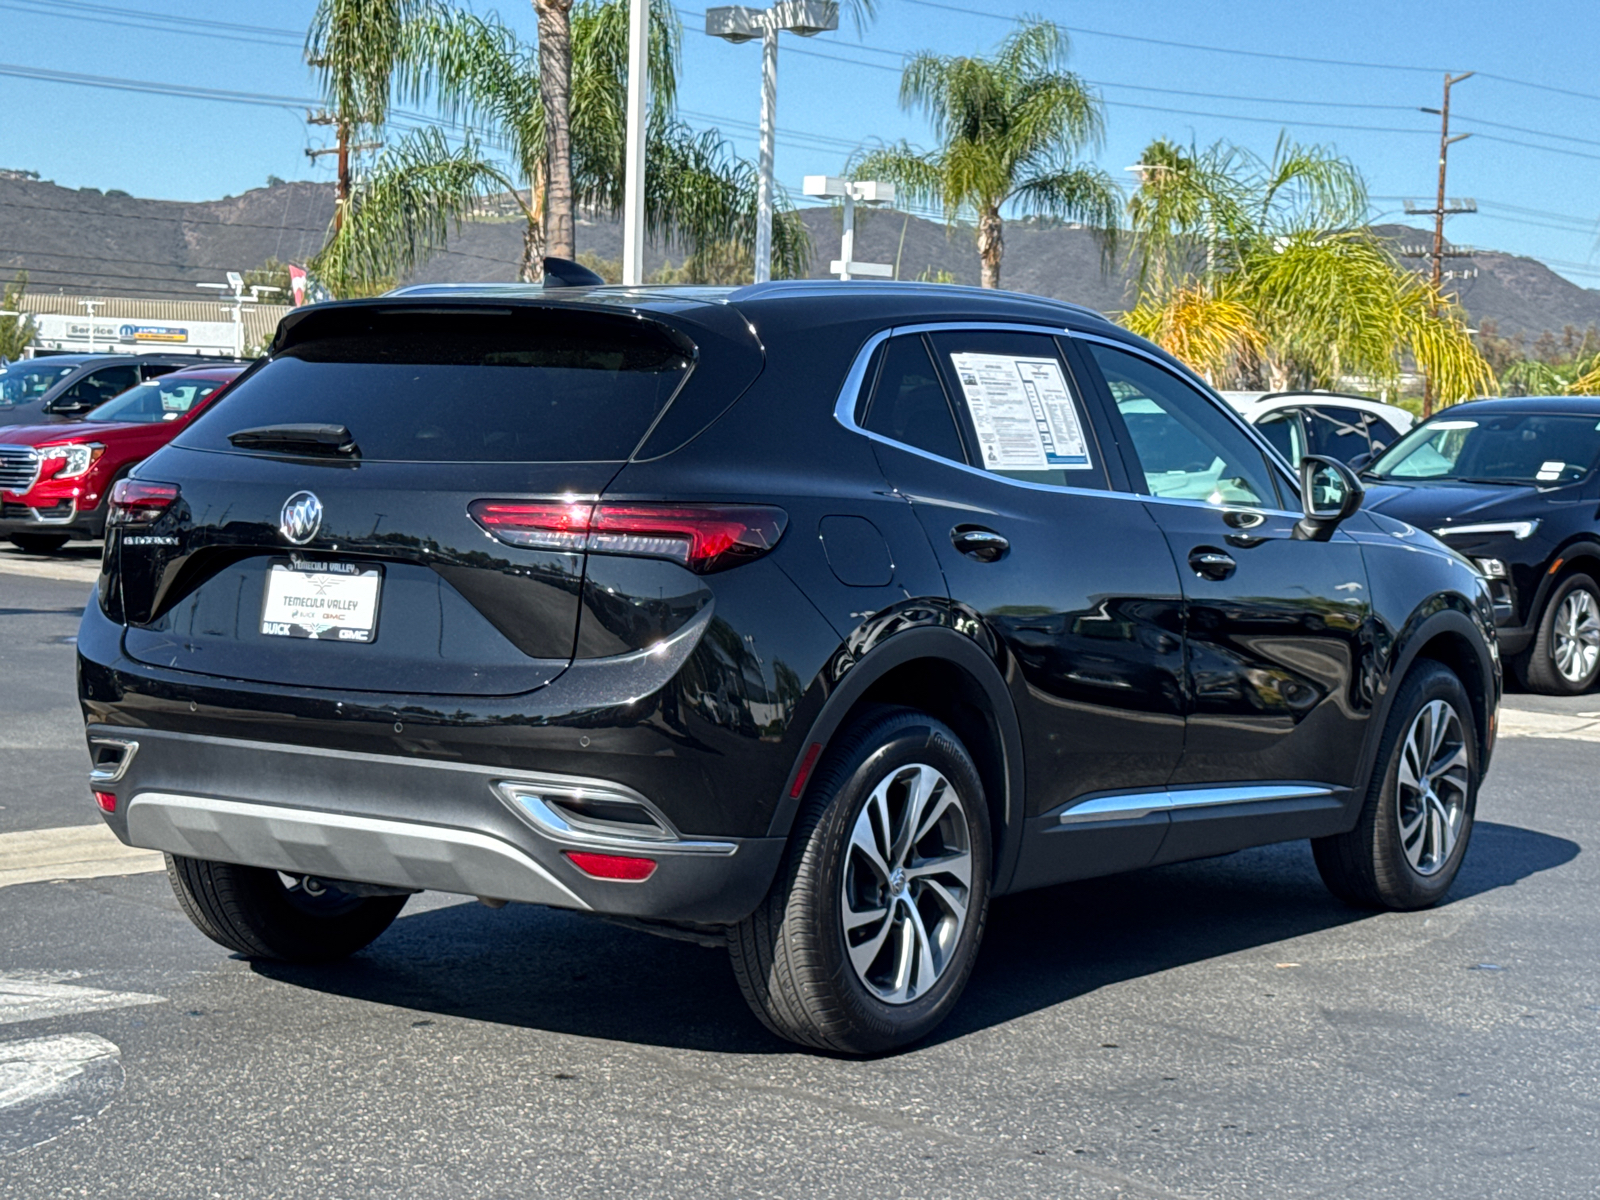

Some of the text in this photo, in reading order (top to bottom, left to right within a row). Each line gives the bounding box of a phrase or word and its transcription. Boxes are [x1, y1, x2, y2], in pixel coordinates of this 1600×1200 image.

[71, 325, 114, 335] Service
[294, 560, 356, 574] TEMECULA VALLEY
[283, 596, 359, 611] TEMECULA VALLEY
[322, 612, 346, 621] GMC
[262, 622, 369, 641] BUICK GMC
